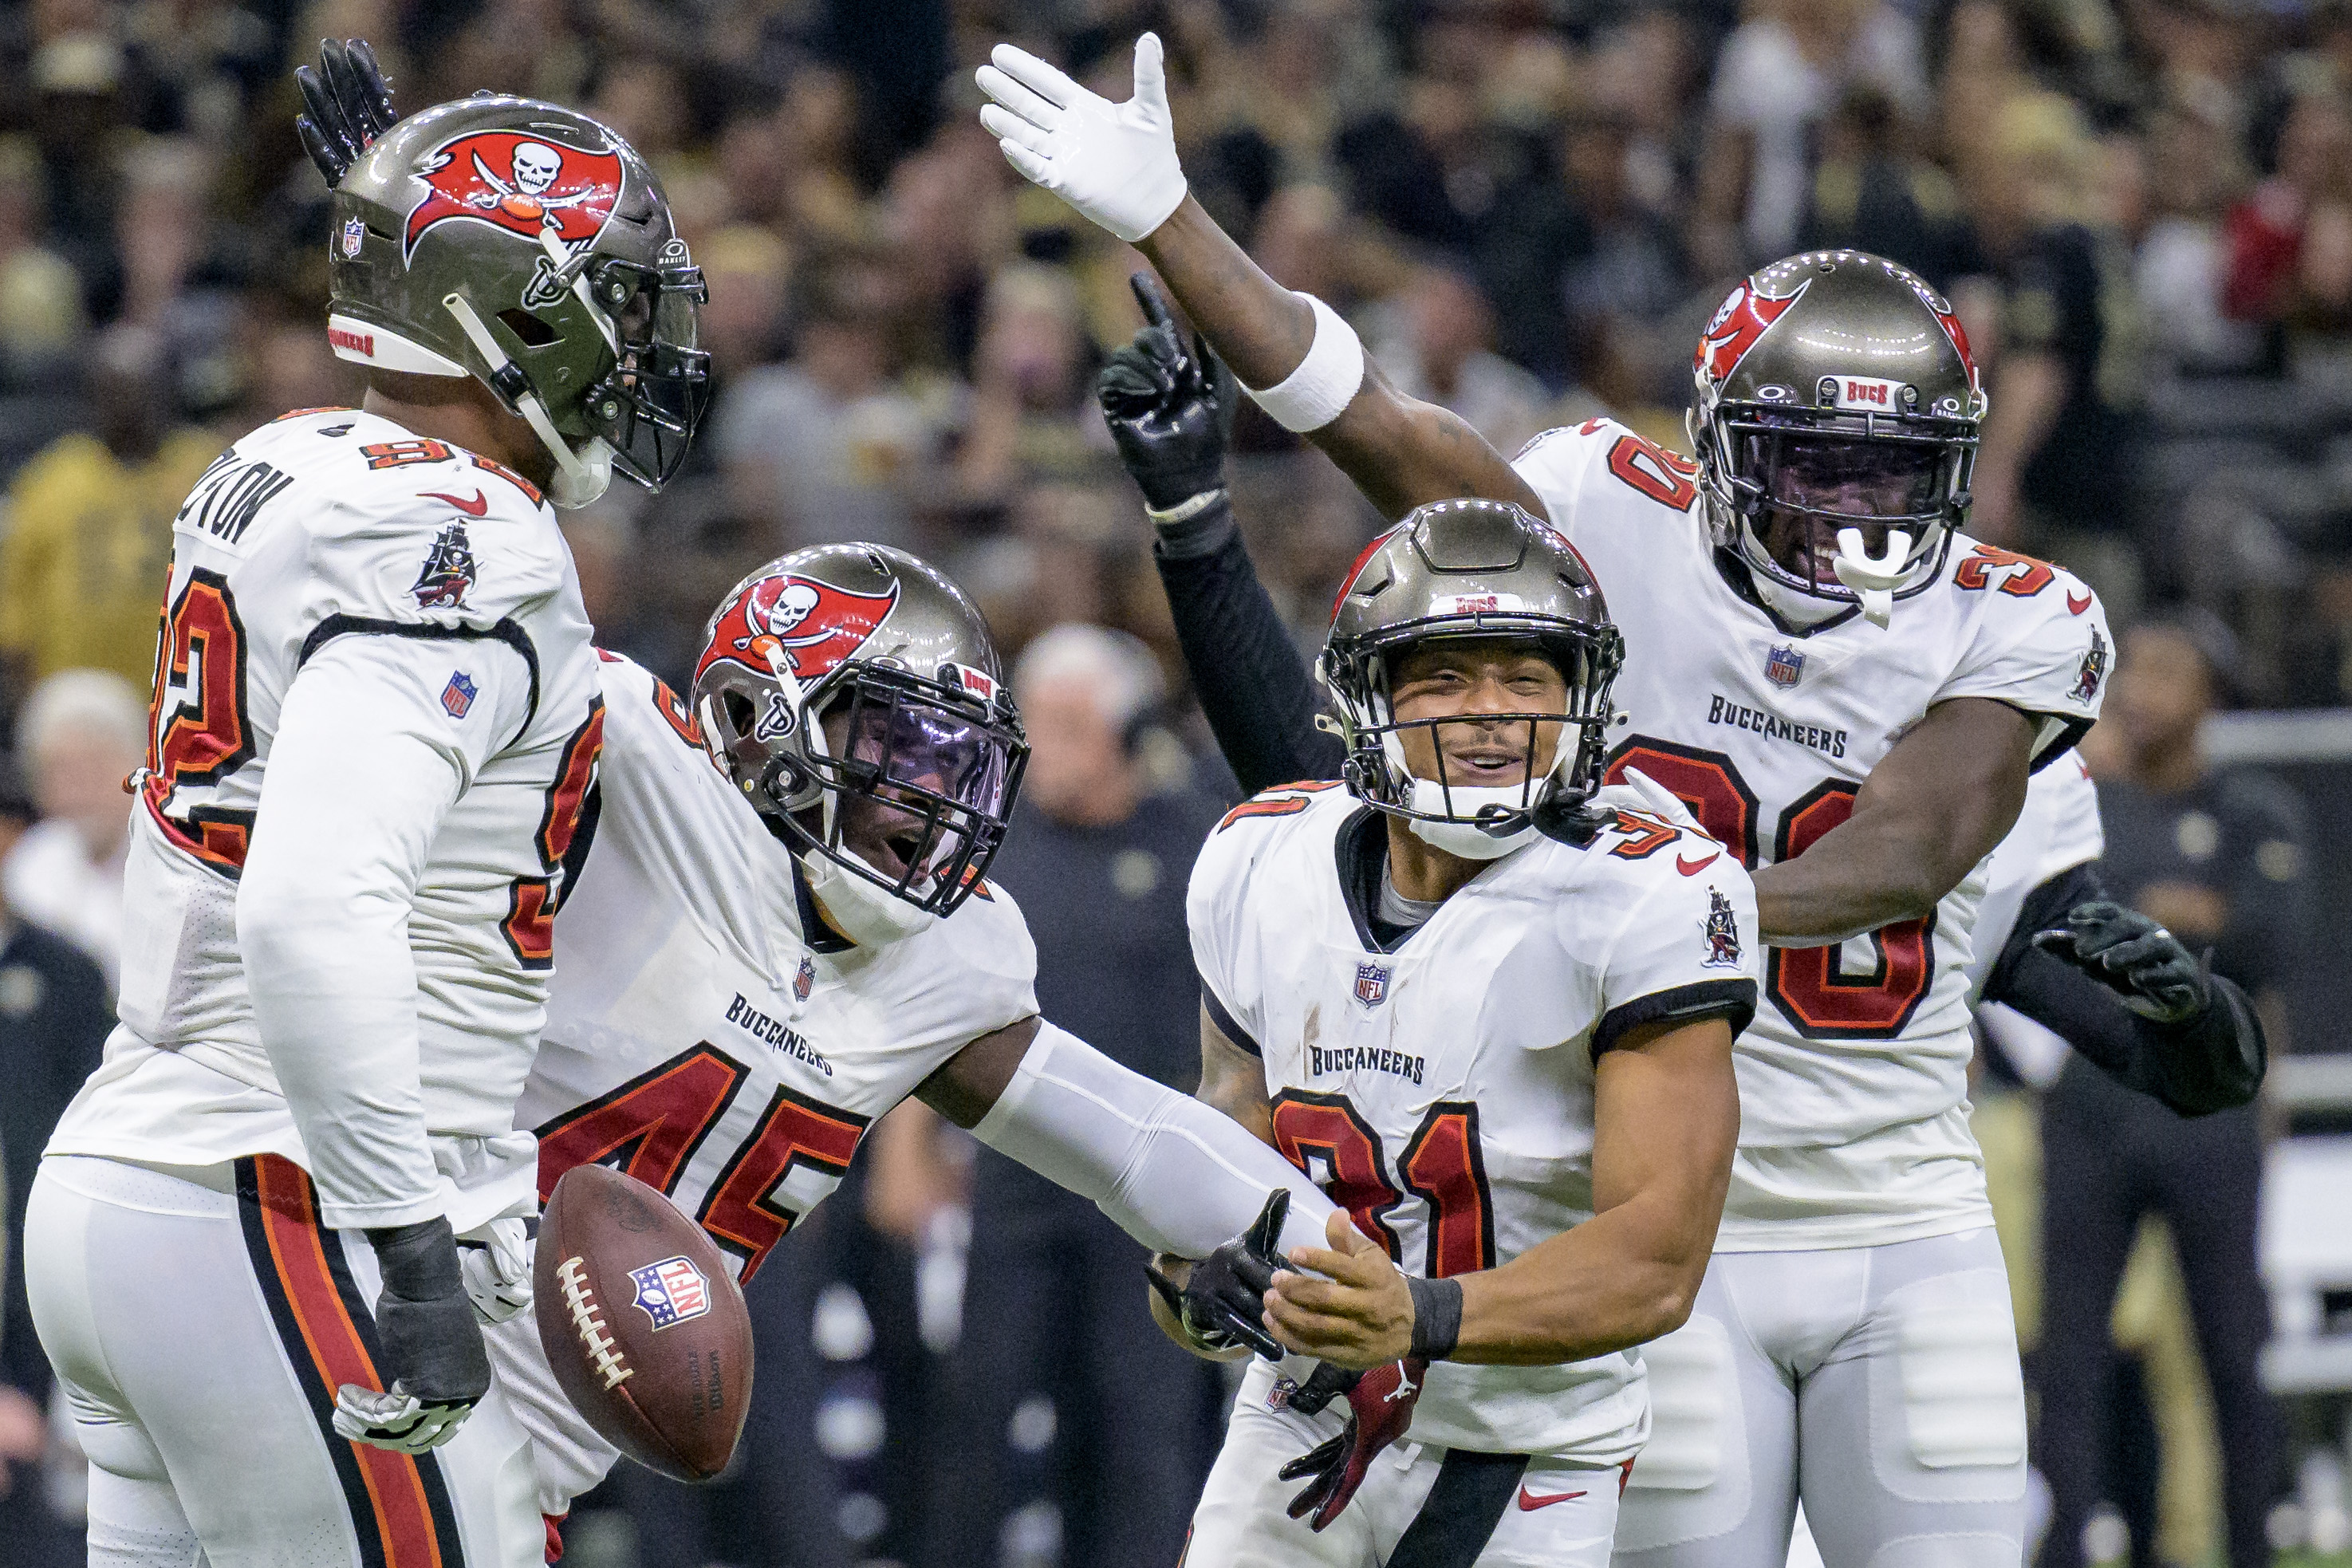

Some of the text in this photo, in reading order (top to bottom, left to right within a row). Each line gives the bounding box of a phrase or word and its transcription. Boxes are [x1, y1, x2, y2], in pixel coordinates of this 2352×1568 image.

[1847, 380, 1888, 405] BUCS
[1770, 661, 1795, 683] NFL
[1708, 693, 1848, 758] BUCCANEERS
[1358, 979, 1381, 999] NFL
[1309, 1044, 1425, 1085] BUCCANEERS
[663, 1262, 703, 1314] NFL
